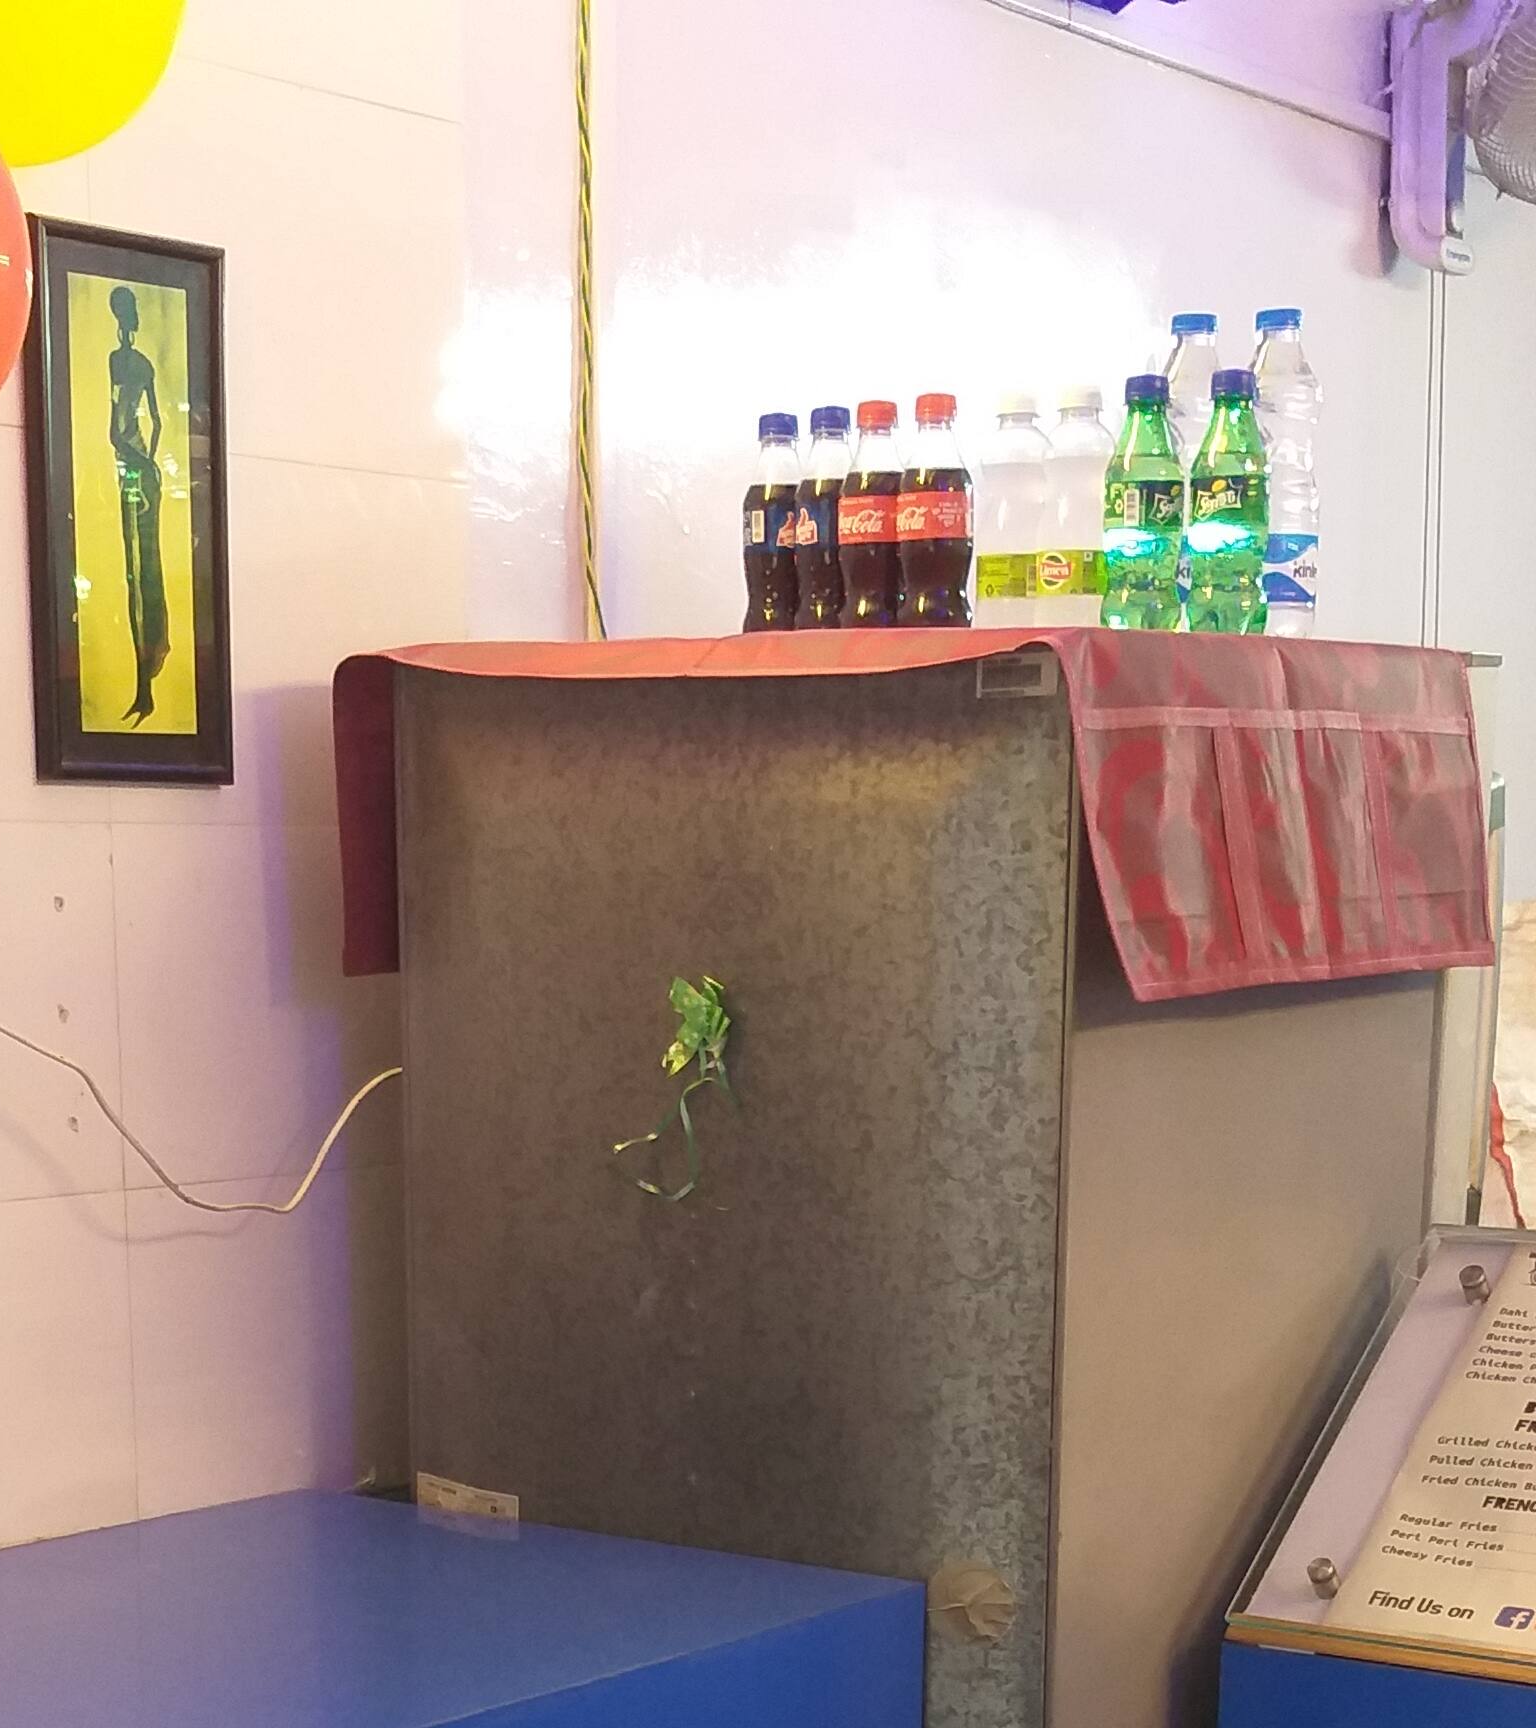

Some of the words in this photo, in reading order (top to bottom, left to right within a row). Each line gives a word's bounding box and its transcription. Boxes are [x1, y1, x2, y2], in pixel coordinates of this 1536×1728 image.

[1438, 1436, 1489, 1448] Grilled
[1429, 1455, 1475, 1466] Pulled
[1480, 1457, 1533, 1471] Chicken
[1422, 1474, 1458, 1486] Fried
[1464, 1478, 1517, 1491] Chicken
[1400, 1513, 1453, 1529] Regular
[1460, 1521, 1498, 1532] Fries
[1390, 1529, 1421, 1542] Peri
[1428, 1536, 1458, 1549] Peri
[1466, 1540, 1504, 1552] Fries
[1381, 1545, 1428, 1562] Cheesy
[1435, 1554, 1473, 1568] Fries
[1368, 1590, 1414, 1611] Find
[1416, 1598, 1442, 1615] Us
[1448, 1606, 1475, 1621] on
